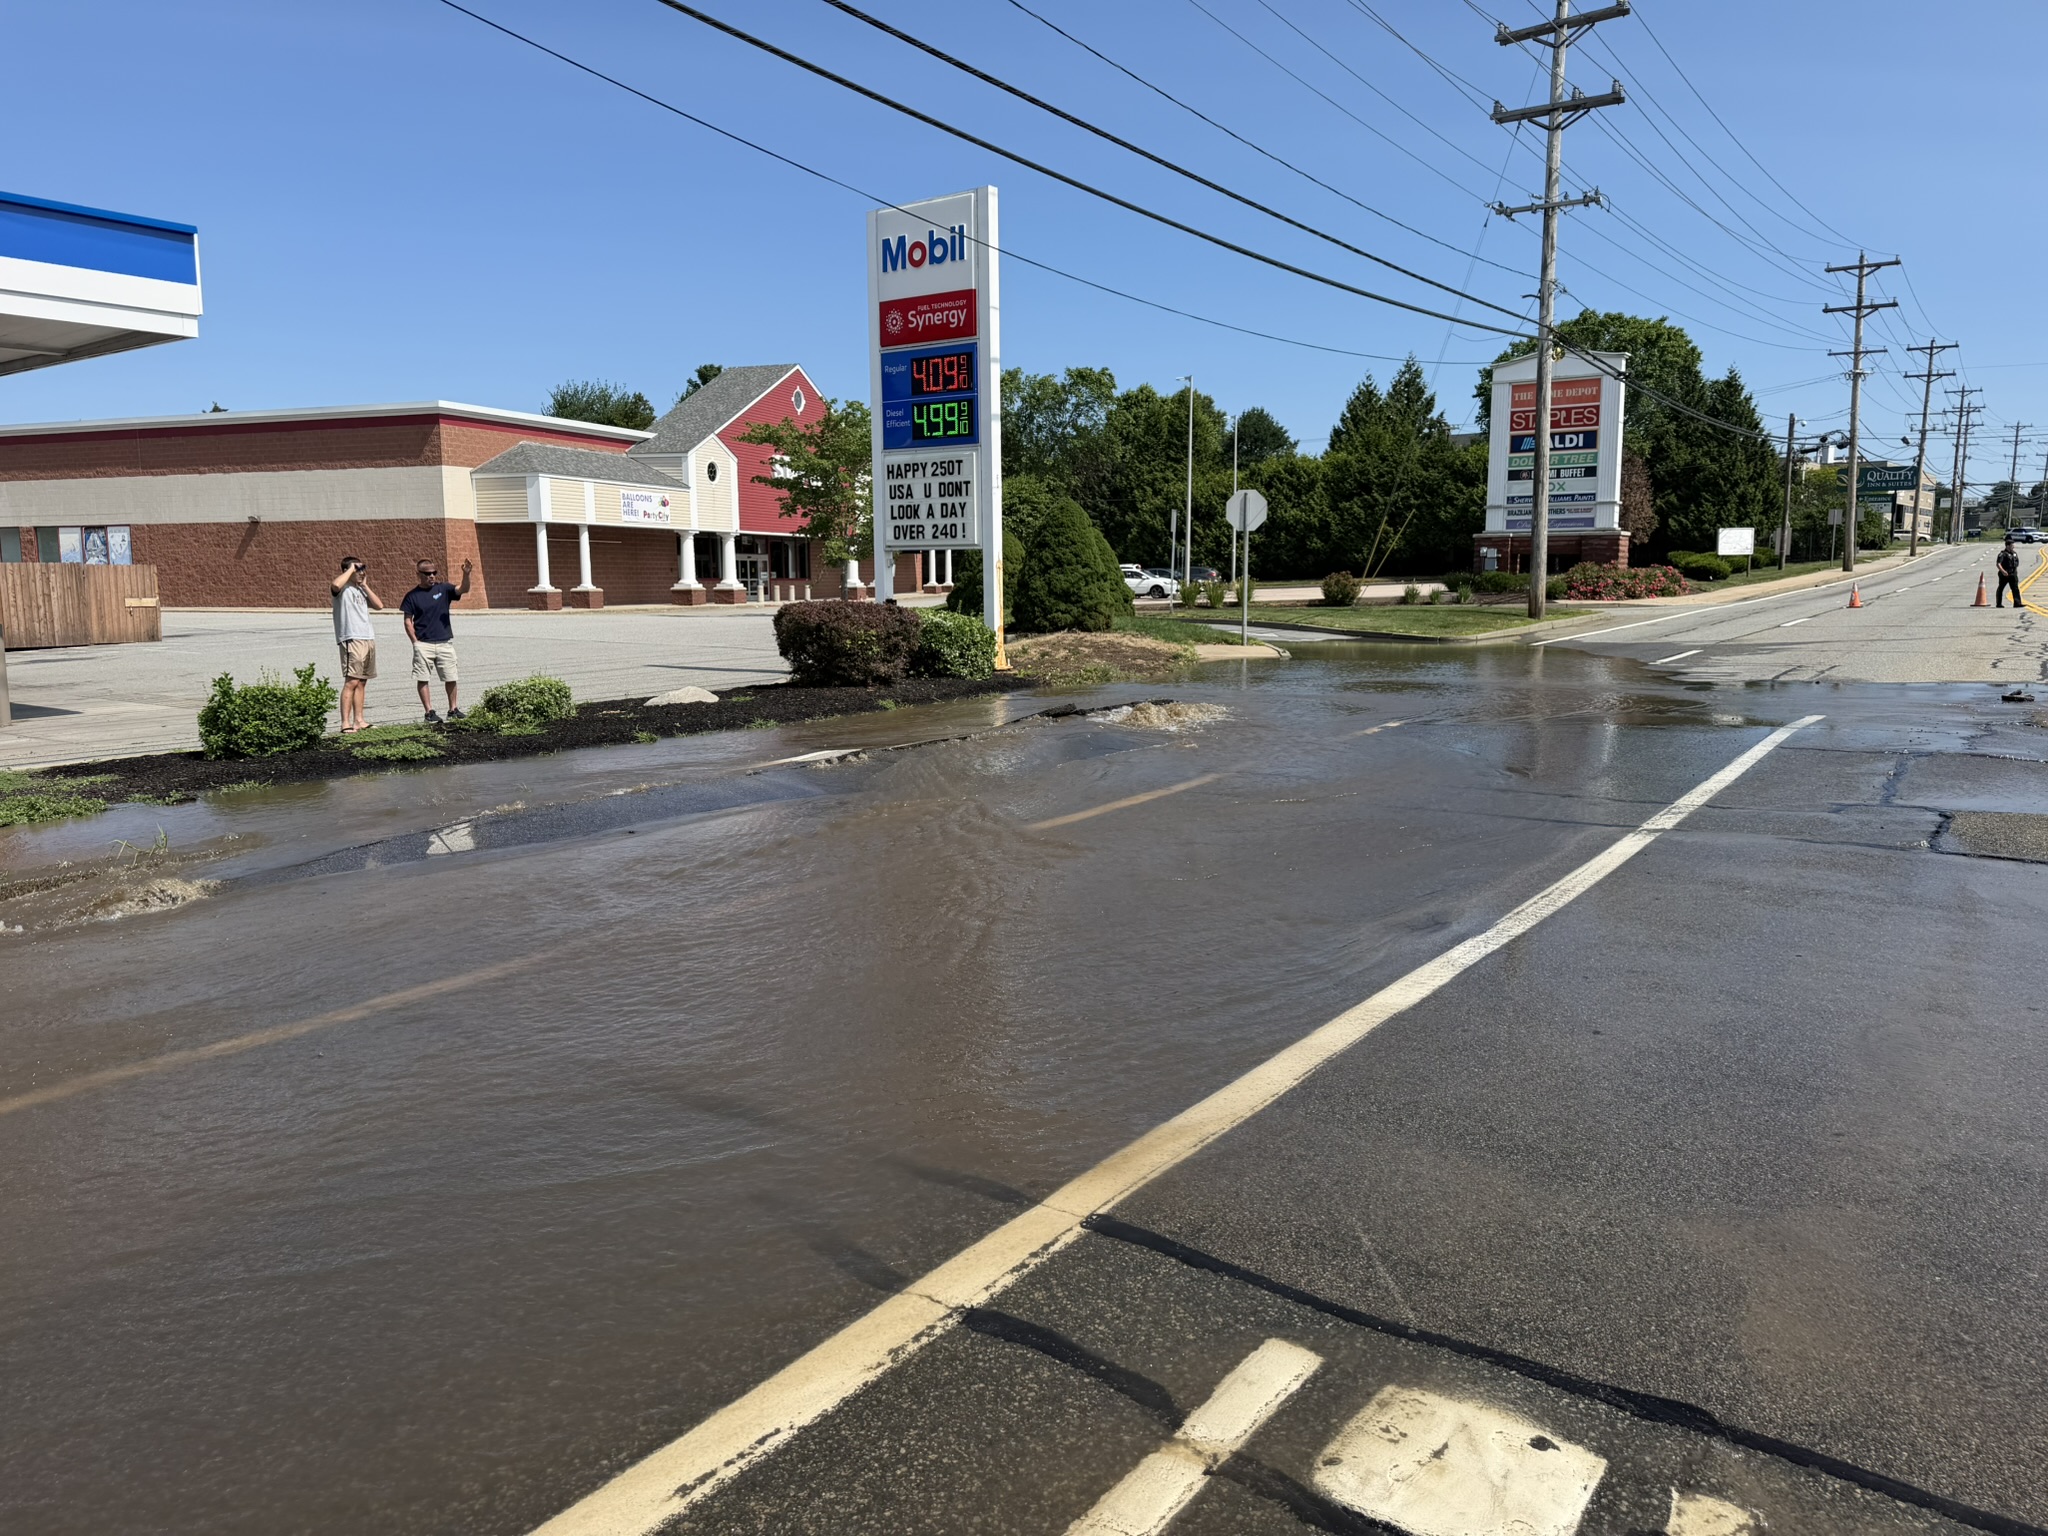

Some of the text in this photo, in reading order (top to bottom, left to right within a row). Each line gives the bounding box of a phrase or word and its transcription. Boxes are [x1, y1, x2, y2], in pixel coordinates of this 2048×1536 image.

[882, 224, 965, 273] Mobil
[917, 300, 967, 312] FUEL TECHNOLOGY
[908, 309, 967, 331] Synergy
[884, 364, 907, 373] Regular
[913, 356, 958, 391] 4.09
[1514, 391, 1533, 401] THE
[1565, 386, 1598, 397] DEPOT
[886, 409, 904, 418] Diesel
[914, 402, 959, 436] 4.99
[1512, 407, 1597, 429] STPLES
[886, 419, 910, 428] Efficient
[1511, 453, 1595, 466] DOLR TREE
[886, 459, 963, 480] HAPPY 250T
[1560, 467, 1586, 478] BUFFET
[1866, 470, 1913, 482] QUALITY
[622, 493, 653, 503] BALLOONS
[889, 481, 971, 500] USA U DONT
[623, 508, 639, 517] HERE!
[890, 502, 967, 520] LOOK A DAY
[893, 524, 925, 540] OVER
